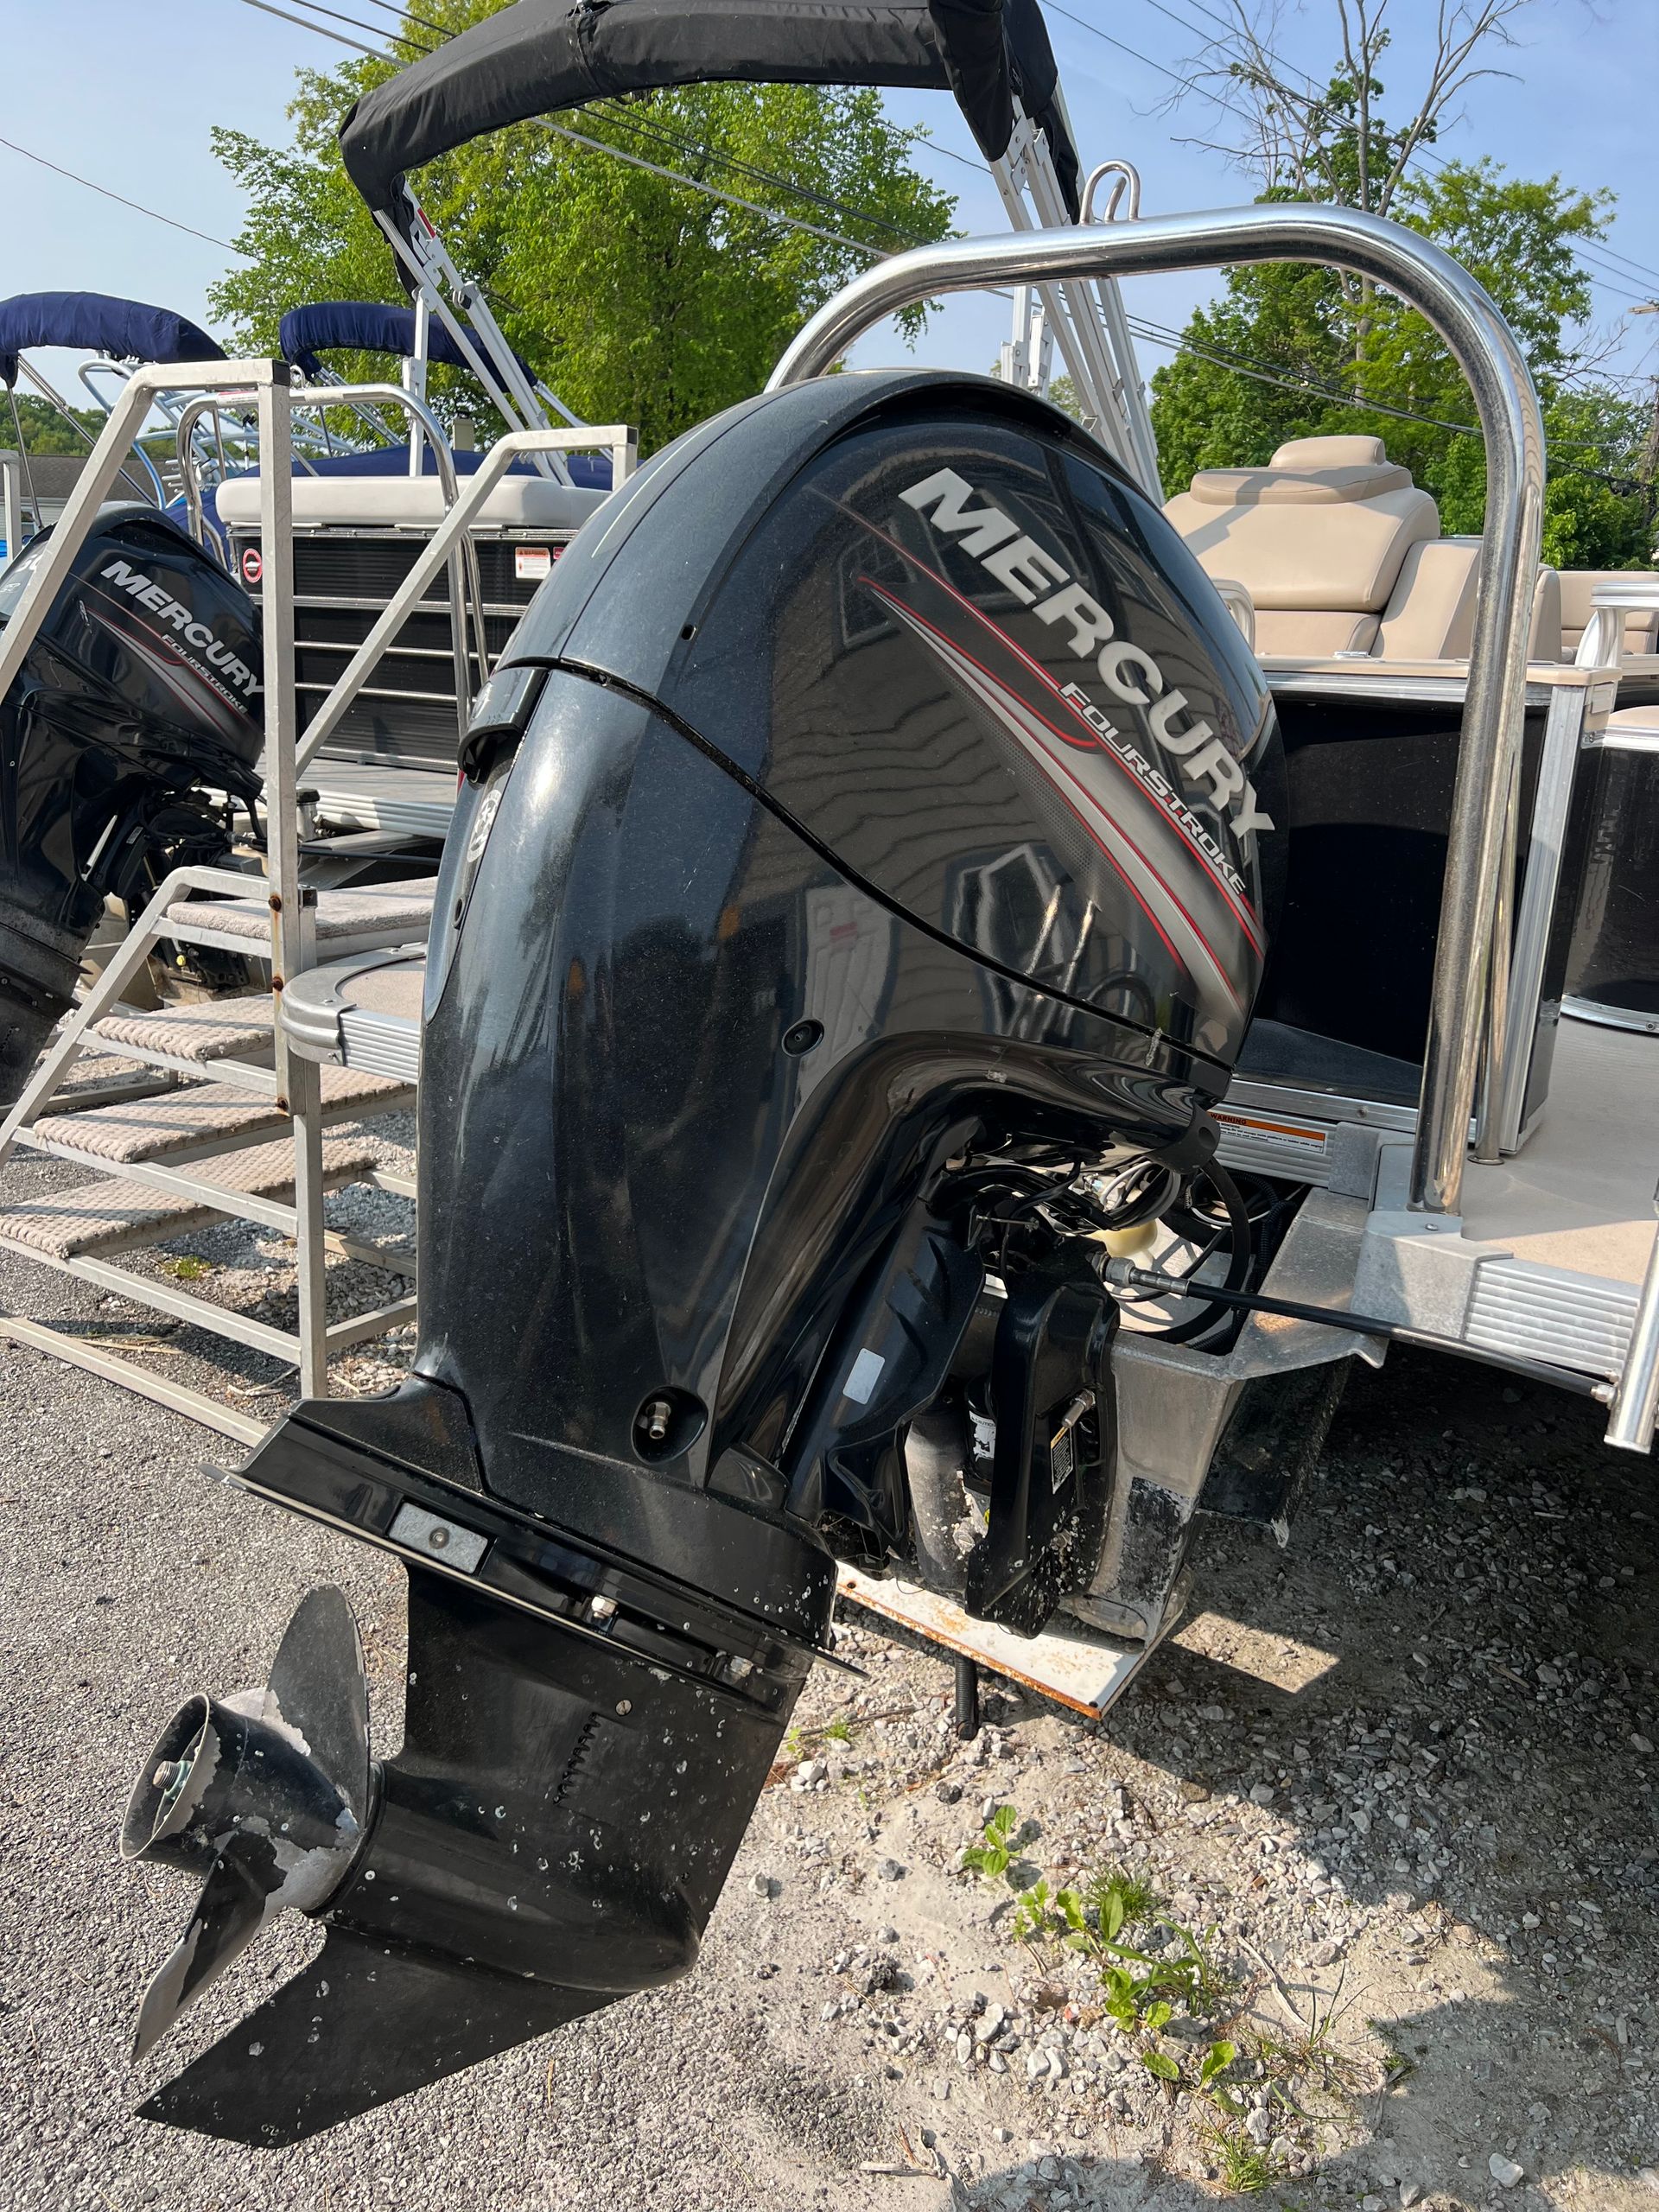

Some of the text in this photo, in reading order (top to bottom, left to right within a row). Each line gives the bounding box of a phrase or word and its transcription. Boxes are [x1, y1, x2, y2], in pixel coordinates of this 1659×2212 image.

[100, 560, 264, 696] MERCURY
[161, 633, 248, 714] FOURSTROKE
[898, 467, 1275, 839] MERCURY
[1060, 681, 1245, 895] FOURSTROKE
[1211, 1113, 1246, 1125] WARNING
